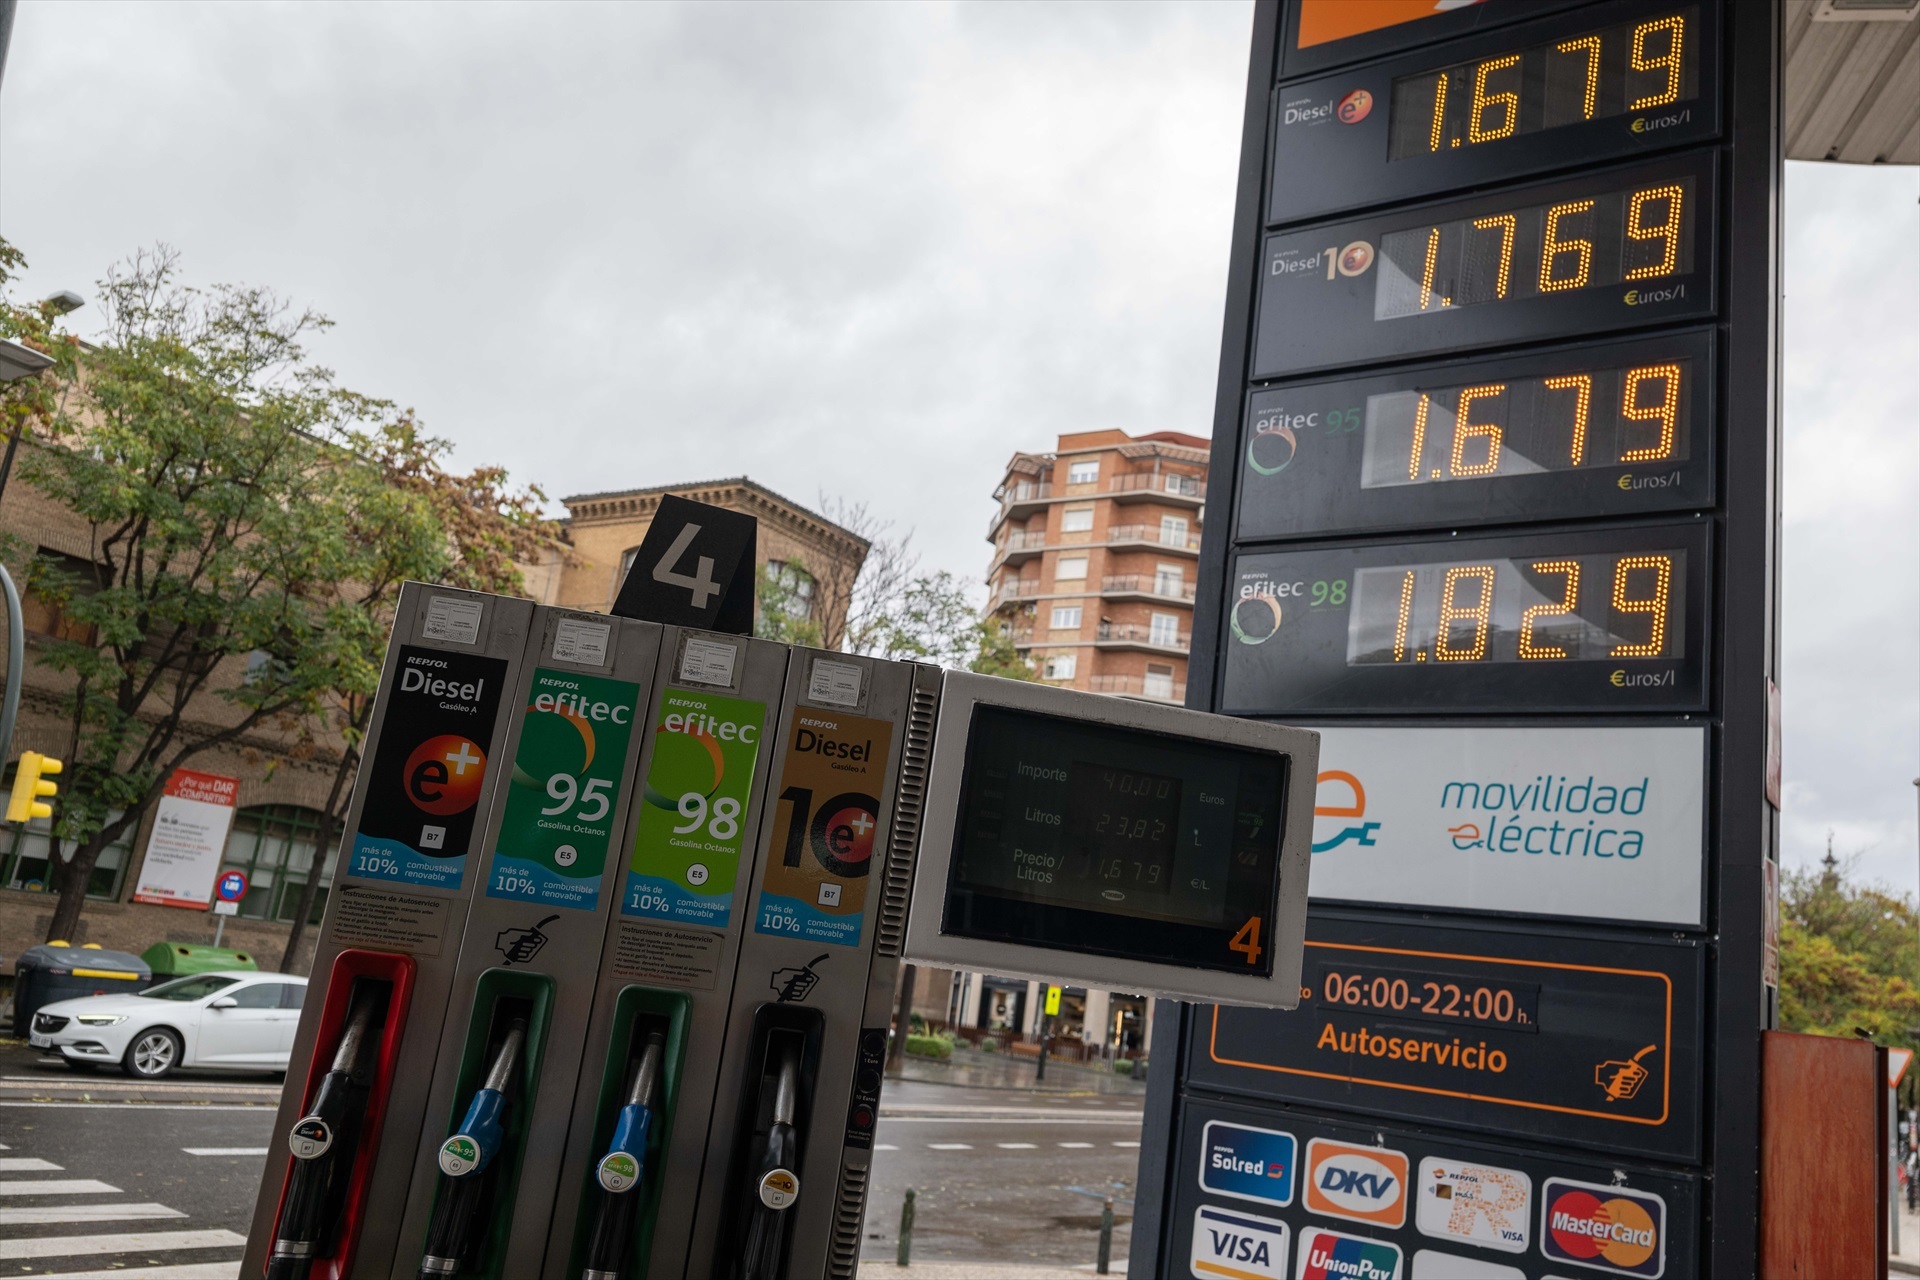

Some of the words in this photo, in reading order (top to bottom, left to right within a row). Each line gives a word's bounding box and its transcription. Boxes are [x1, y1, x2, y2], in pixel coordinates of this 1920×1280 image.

[1429, 15, 1685, 152] 1.679
[1285, 99, 1333, 125] Diesel
[1419, 184, 1684, 311] 1.769
[1271, 252, 1321, 276] Diesel
[1256, 412, 1320, 433] efitec
[1324, 406, 1362, 436] 95
[1409, 363, 1682, 480] 1.679
[651, 522, 721, 611] 4
[1240, 581, 1304, 599] efitec
[1310, 579, 1348, 607] 98
[1394, 555, 1672, 663] 1.829
[407, 656, 449, 669] REPSOL
[400, 667, 485, 702] Diesel
[540, 678, 580, 690] REPSOL
[439, 701, 470, 713] Gasóleo
[470, 706, 479, 714] A
[535, 692, 631, 725] efitec
[668, 697, 708, 710] REPSOL
[664, 712, 757, 745] efitec
[800, 717, 839, 730] REPSOL
[795, 728, 872, 763] Diesel
[831, 761, 859, 773] Gasóleo
[860, 766, 867, 775] A
[213, 779, 235, 795] DAR
[1017, 760, 1068, 783] Importe
[1199, 792, 1225, 806] Euros
[541, 773, 614, 822] 95
[1440, 776, 1650, 816] movilidad
[672, 791, 742, 841] 98
[1025, 807, 1062, 826] Litros
[426, 832, 440, 842] B7
[537, 819, 572, 832] Gasolina
[573, 823, 607, 836] Octanos
[361, 845, 378, 857] más
[380, 847, 393, 858] de
[669, 838, 703, 850] Gasolina
[704, 842, 737, 854] Octanos
[560, 851, 572, 861] E5
[1013, 847, 1055, 868] Precio
[357, 856, 400, 877] 10%
[406, 862, 460, 876] combustible
[499, 865, 517, 876] más
[518, 868, 530, 878] de
[692, 870, 704, 879] E5
[1017, 865, 1054, 885] Litros
[404, 870, 447, 883] renovable
[495, 875, 537, 896] 10%
[541, 890, 583, 902] renovable
[543, 881, 595, 895] combustible
[633, 883, 652, 893] más
[652, 885, 664, 895] de
[824, 890, 837, 899] B7
[343, 889, 387, 901] Instrucciones
[388, 895, 397, 903] de
[398, 896, 440, 908] Autoservicio
[630, 893, 671, 913] 10%
[676, 898, 726, 912] combustible
[675, 907, 715, 919] renovable
[765, 903, 783, 914] más
[783, 906, 795, 915] de
[762, 913, 802, 933] 10%
[807, 919, 856, 932] combustible
[621, 925, 664, 938] Instrucciones
[664, 931, 672, 939] de
[673, 932, 713, 944] Autoservicio
[805, 927, 845, 940] renovable
[1228, 915, 1262, 965] 4
[1323, 971, 1515, 1023] 06:00-22:00
[1517, 1008, 1533, 1025] h.
[1317, 1022, 1509, 1074] Autoservicio
[463, 1148, 475, 1157] 95
[1211, 1153, 1265, 1177] Solred
[1320, 1166, 1395, 1201] DKV
[1449, 1172, 1480, 1183] REPSOL
[1501, 1229, 1524, 1243] VISA
[1551, 1210, 1656, 1248] MasterCard
[1207, 1228, 1271, 1268] VISA
[1310, 1249, 1392, 1280] UnionPay
